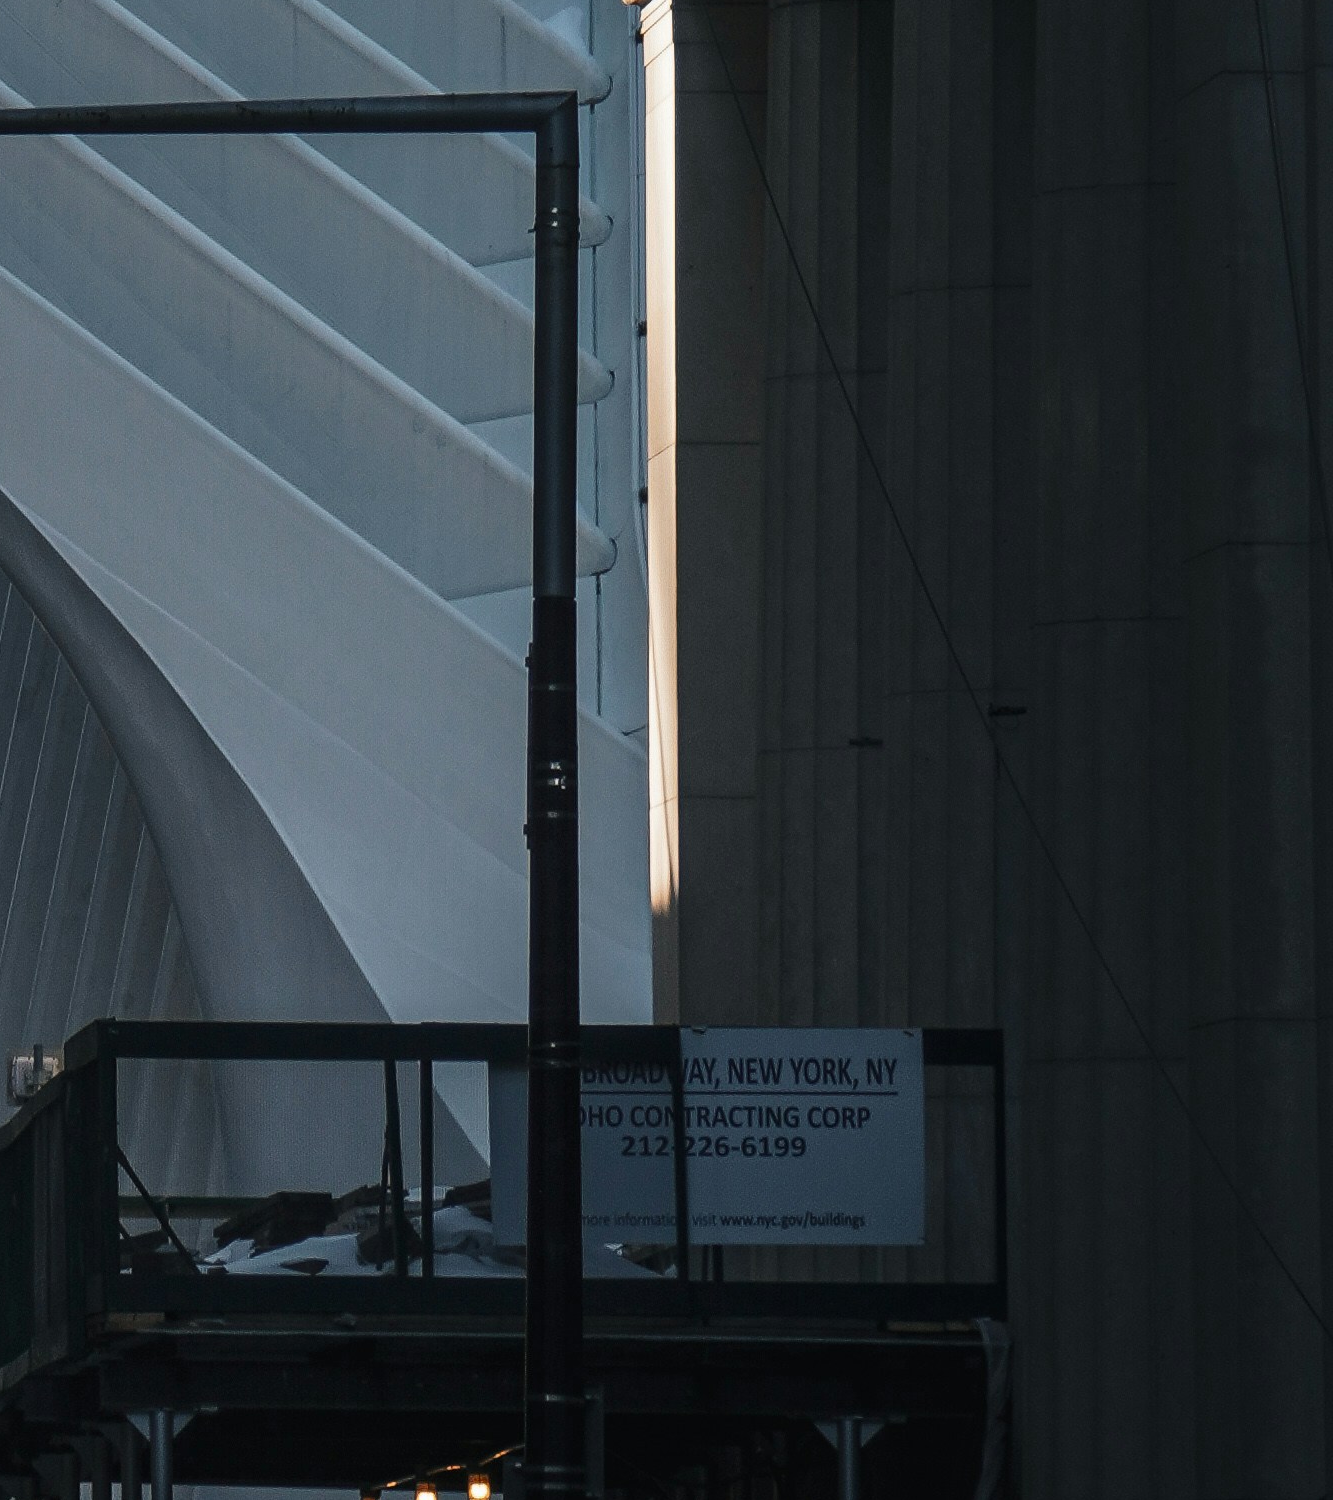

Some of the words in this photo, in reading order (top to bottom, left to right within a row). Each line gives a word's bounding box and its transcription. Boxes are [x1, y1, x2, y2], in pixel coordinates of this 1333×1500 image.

[727, 1058, 783, 1085] NEW
[790, 1058, 859, 1089] YORK,
[866, 1058, 899, 1086] NY
[807, 1106, 870, 1129] CORP
